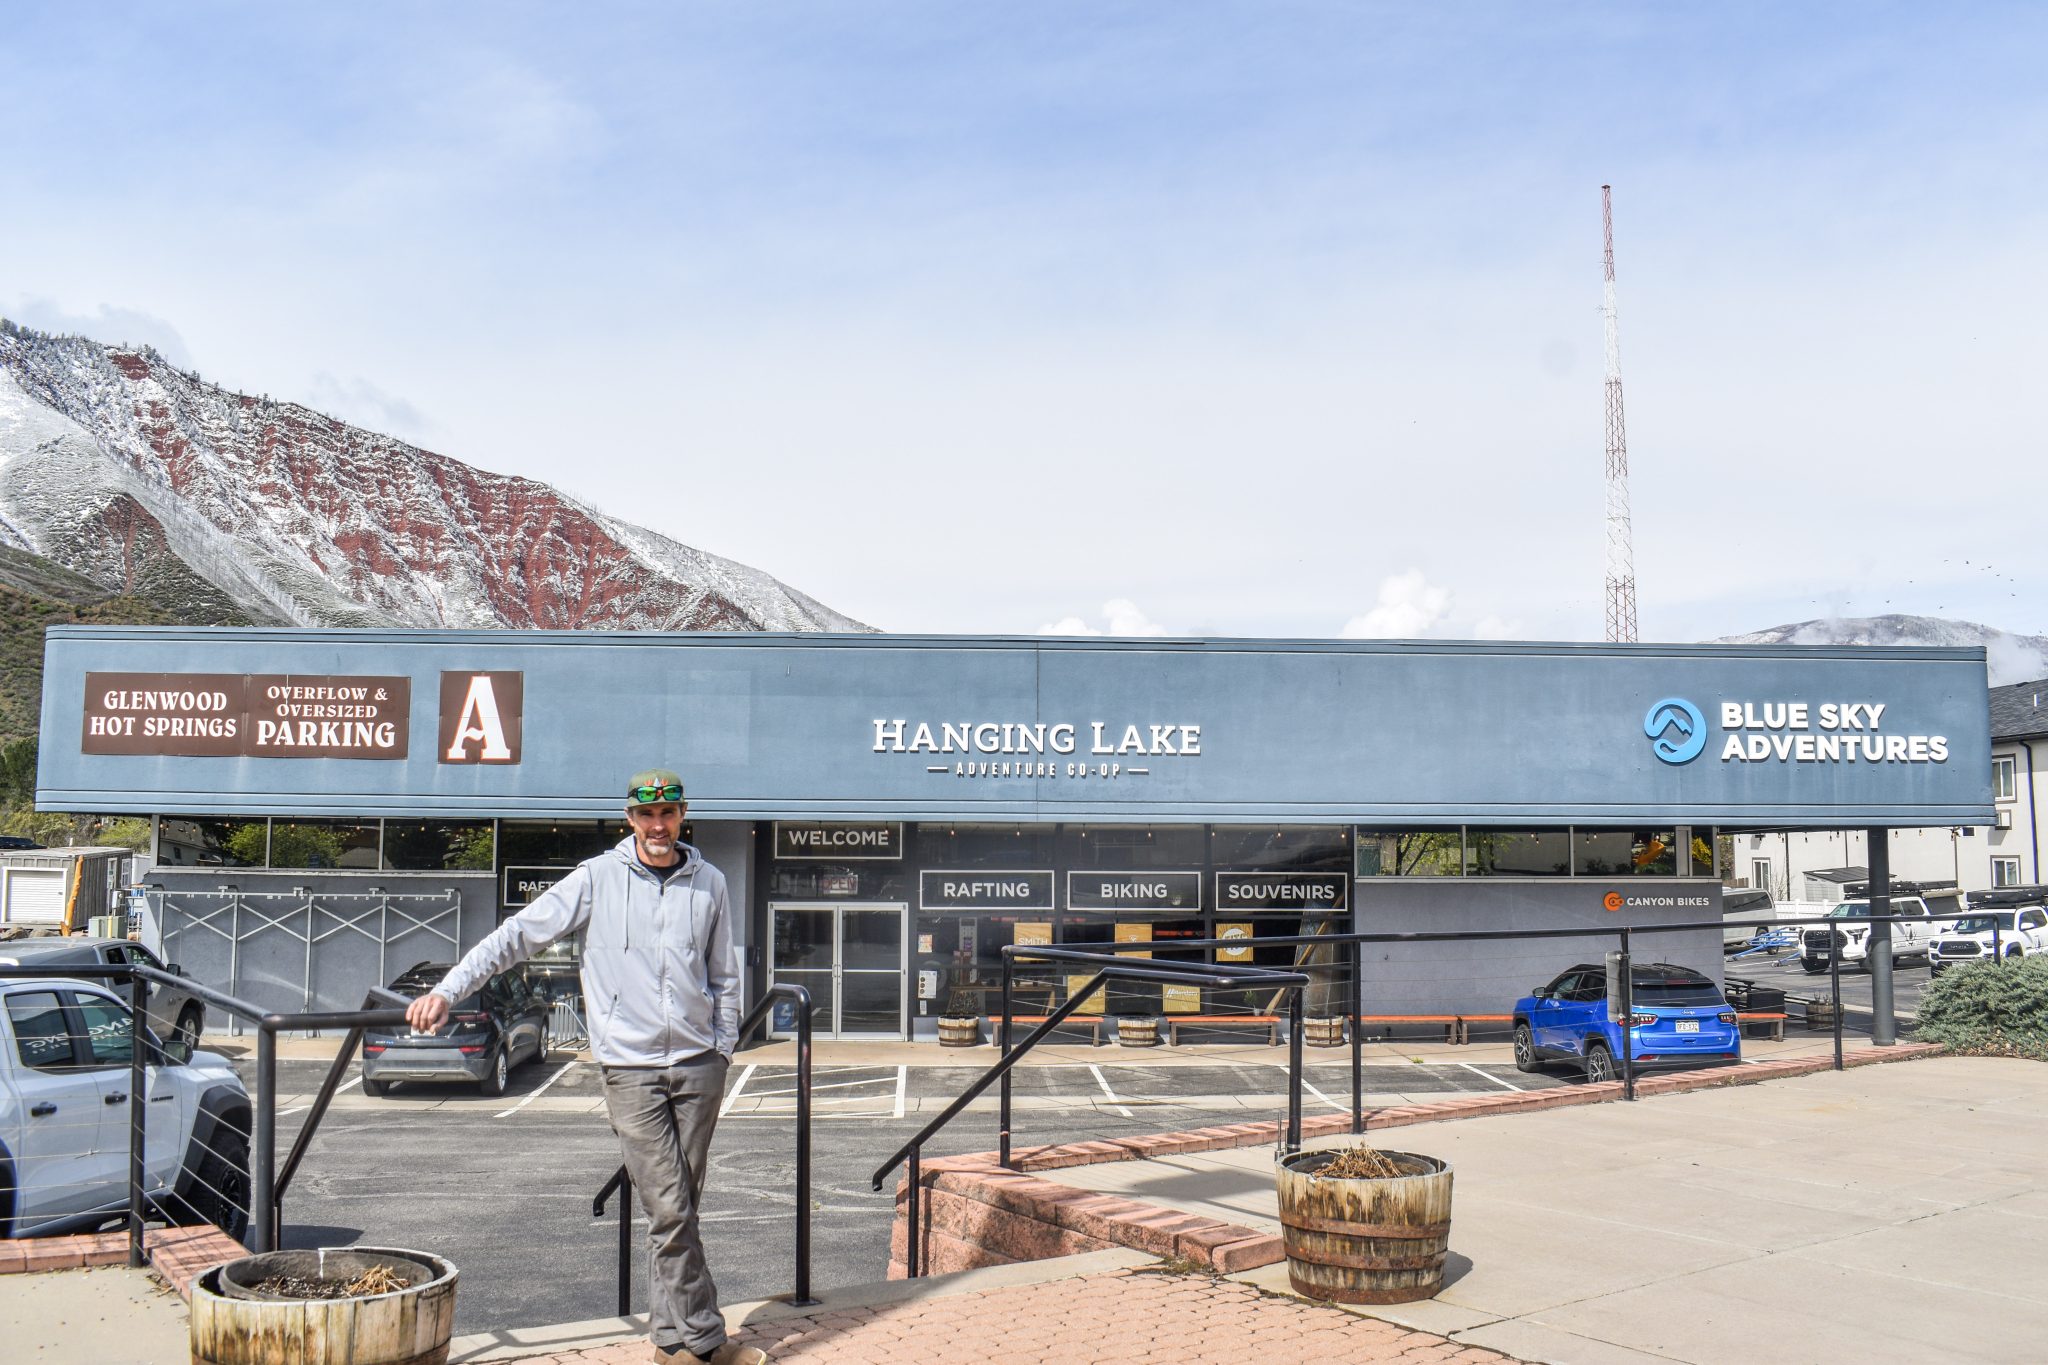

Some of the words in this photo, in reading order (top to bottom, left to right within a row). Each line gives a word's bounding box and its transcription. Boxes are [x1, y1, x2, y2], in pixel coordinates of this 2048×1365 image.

[103, 690, 227, 711] GLENWOOD
[267, 686, 368, 700] OVERFLOW
[374, 687, 388, 701] &
[276, 704, 378, 718] OVERSIZED
[447, 675, 511, 760] A
[1721, 702, 1809, 729] BLUE
[1819, 703, 1886, 730] SKY
[90, 716, 136, 736] HOT
[143, 717, 237, 738] SPRINGS
[256, 720, 396, 748] PARKING
[872, 719, 1075, 753] HANGING
[1091, 721, 1201, 754] LAKE
[1720, 734, 1949, 762] ADVENTURES
[956, 761, 1056, 777] ADVENTURE
[1067, 763, 1120, 778] CO-OP
[788, 830, 889, 846] WELCOME
[518, 881, 558, 892] RAFT
[823, 877, 857, 891] OPEN
[943, 882, 1030, 898] RAFTING
[1101, 883, 1168, 899] BIKING
[1228, 884, 1335, 900] SOUVENIRS
[1626, 897, 1674, 906] CANYON
[1677, 897, 1710, 906] BIKES
[1018, 937, 1048, 945] SMITH
